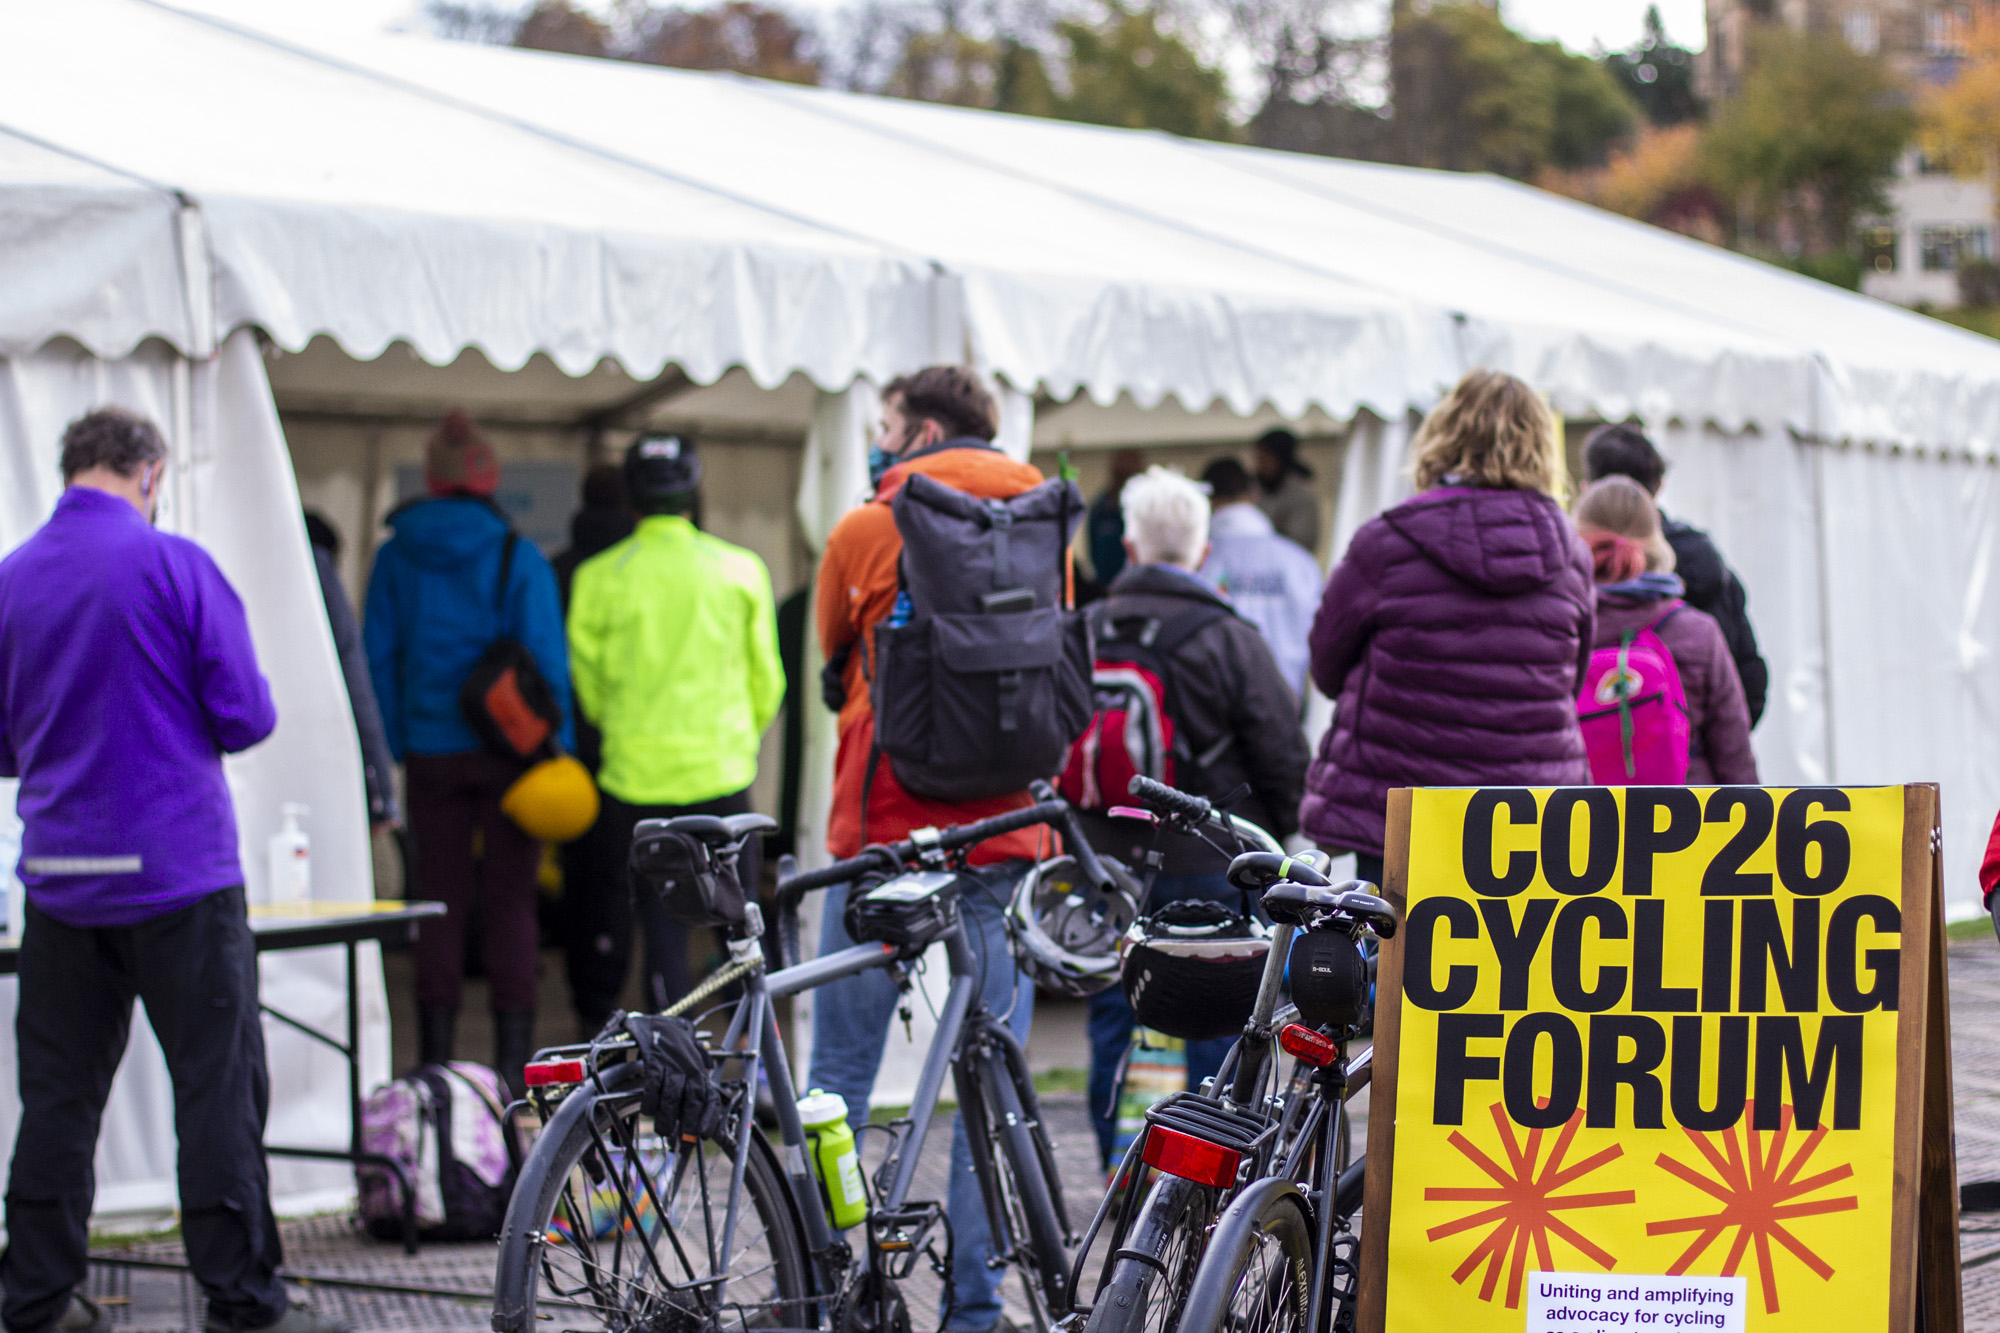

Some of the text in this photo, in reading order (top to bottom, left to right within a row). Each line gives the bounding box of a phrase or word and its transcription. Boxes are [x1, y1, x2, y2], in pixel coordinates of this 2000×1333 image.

[1462, 787, 1851, 898] COP26
[1402, 894, 1902, 1013] CYCLING
[1432, 1012, 1864, 1131] FORUM
[1540, 1283, 1734, 1306] Uniting and amplifying
[1546, 1306, 1726, 1328] advocacy for cycling
